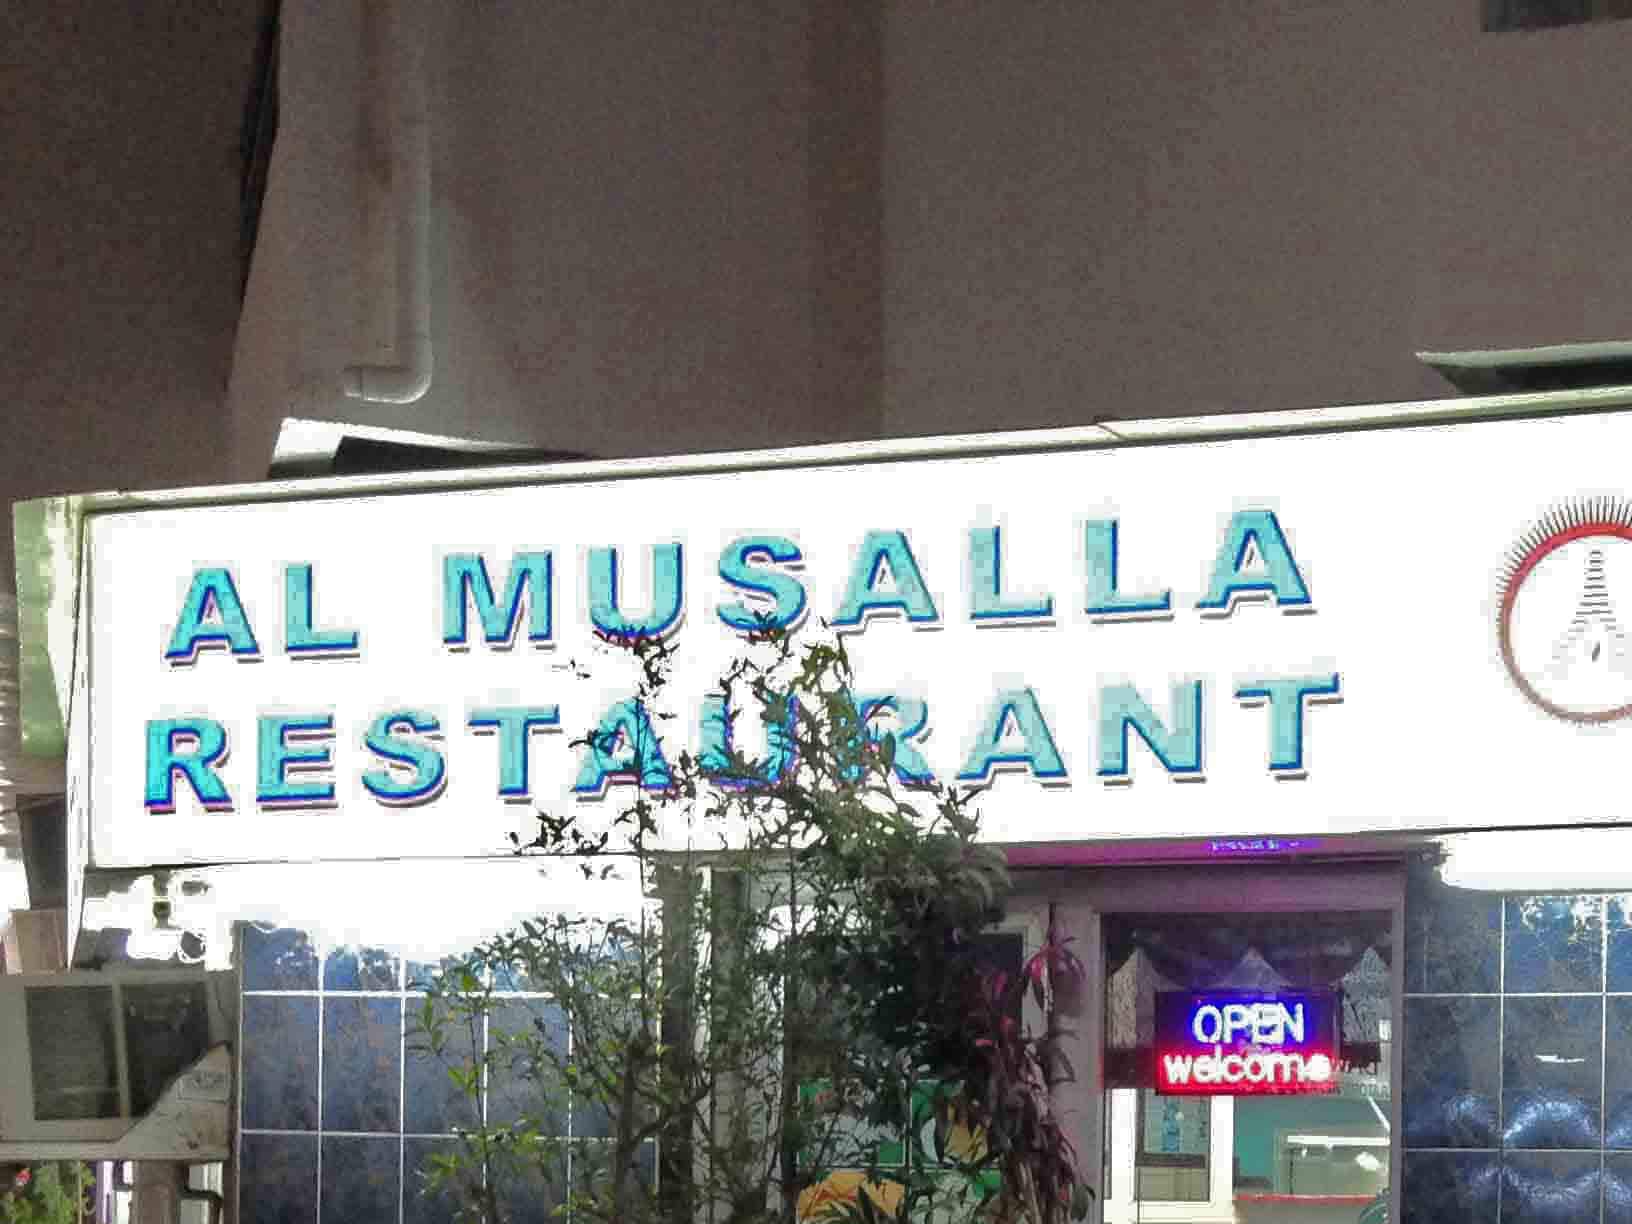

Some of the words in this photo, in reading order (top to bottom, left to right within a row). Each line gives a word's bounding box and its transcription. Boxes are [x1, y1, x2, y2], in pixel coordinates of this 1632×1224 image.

[165, 562, 362, 662] AL
[442, 508, 1316, 649] MUSALLA
[144, 671, 1344, 812] RESTAURANT
[1163, 1044, 1331, 1085] welcome
[1191, 1001, 1305, 1045] OPEN
